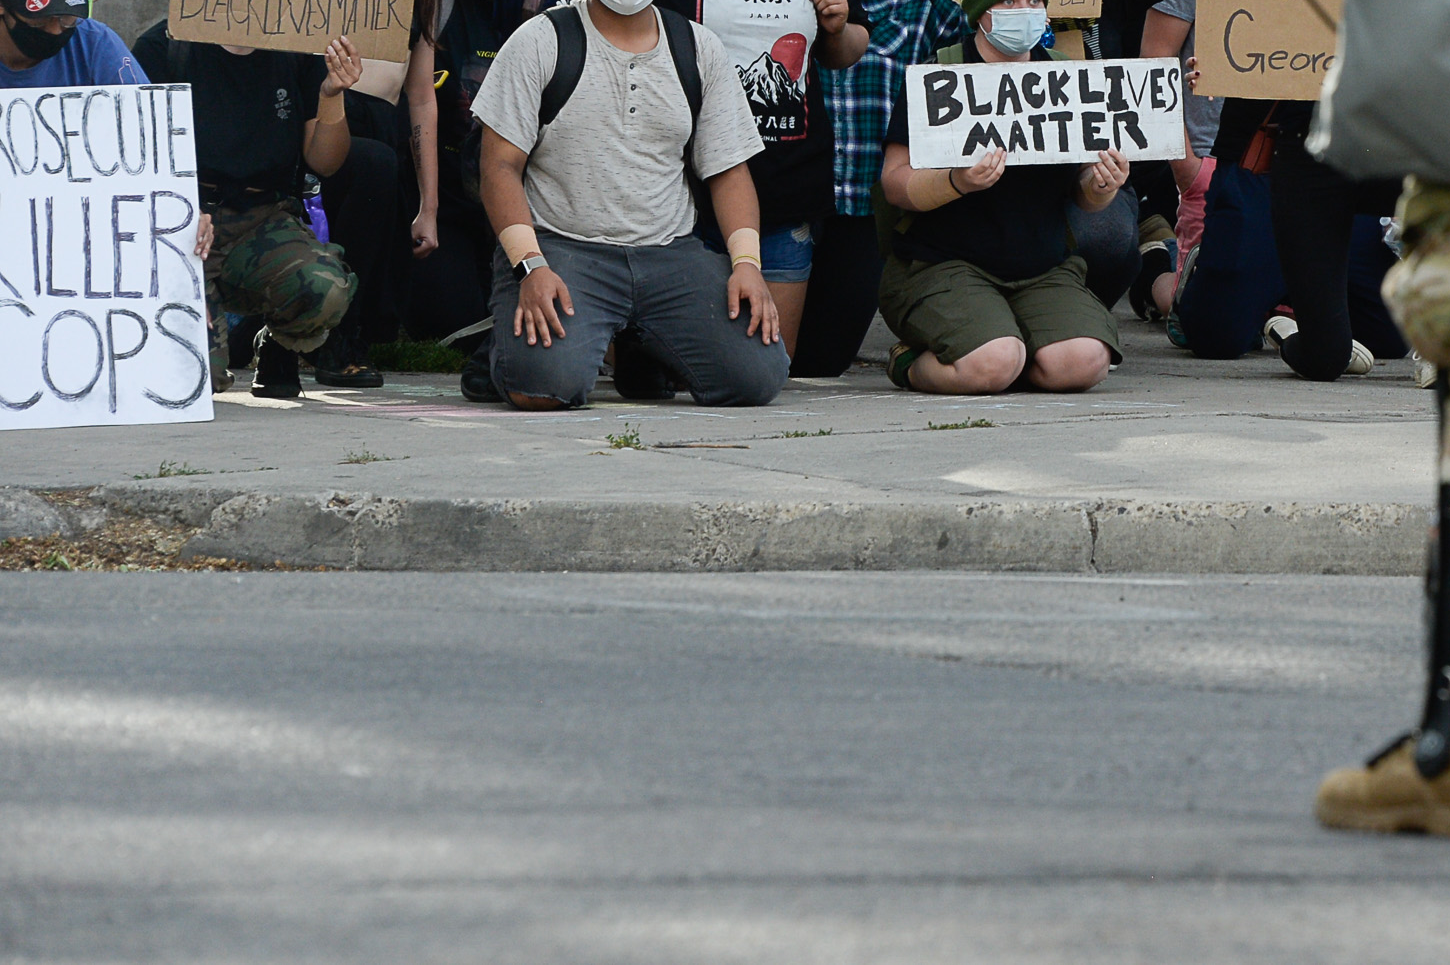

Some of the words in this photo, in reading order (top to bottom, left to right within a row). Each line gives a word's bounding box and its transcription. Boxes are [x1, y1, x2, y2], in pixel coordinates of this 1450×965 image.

[749, 12, 790, 20] JAPAN
[476, 50, 498, 59] NIGH
[923, 68, 1071, 127] BLACK
[1077, 65, 1180, 113] LIVES
[961, 110, 1149, 157] MATTER
[0, 190, 201, 300] ILLER
